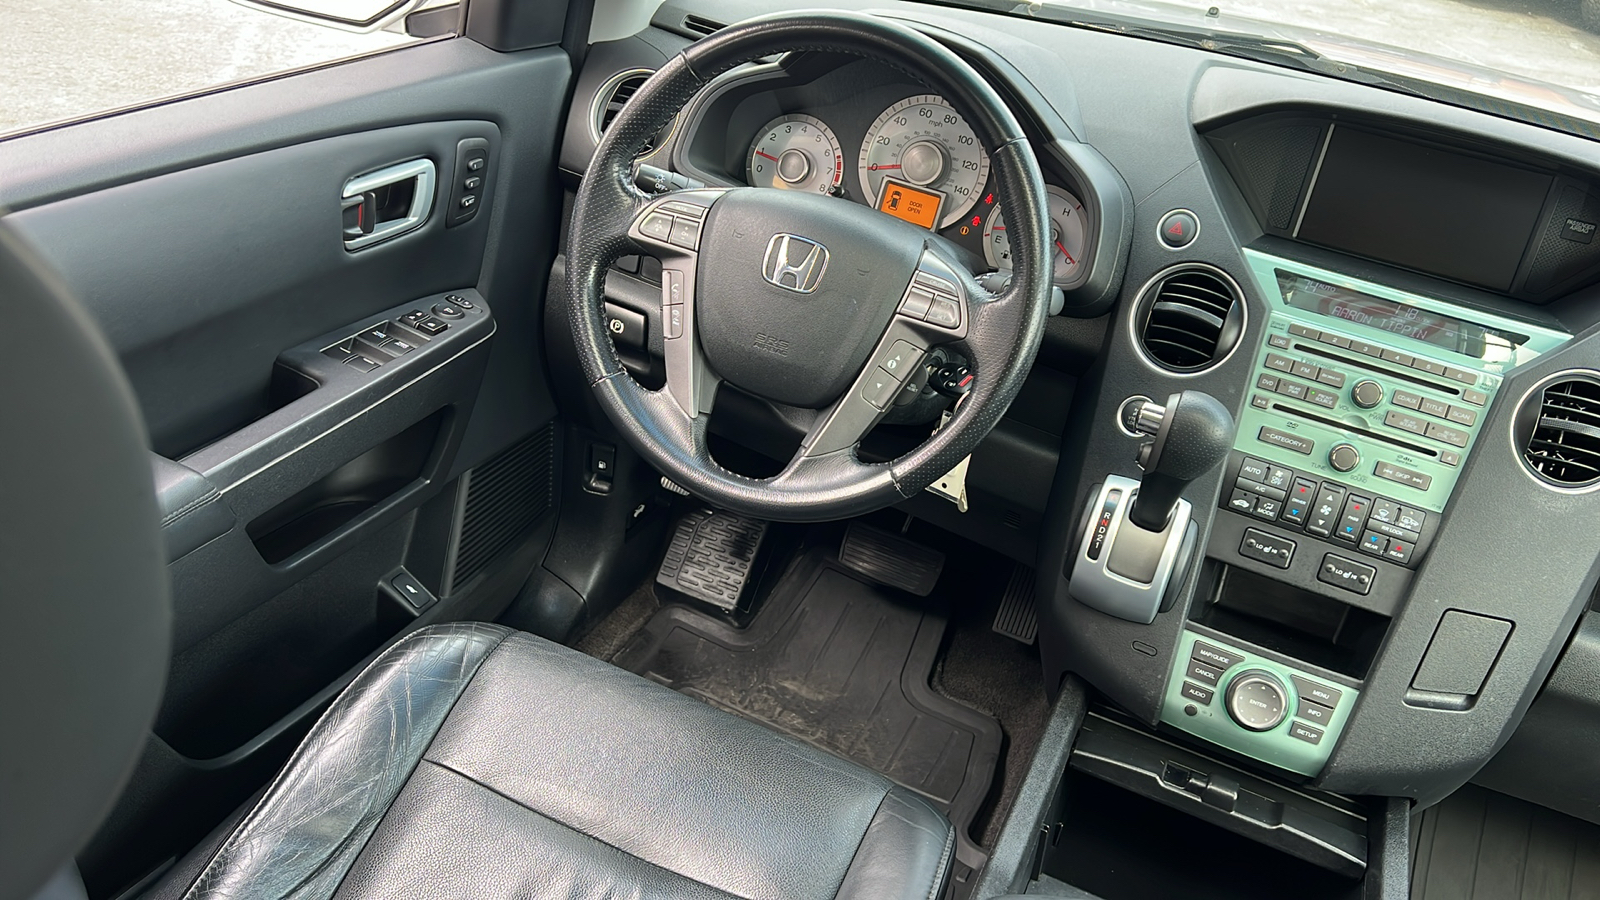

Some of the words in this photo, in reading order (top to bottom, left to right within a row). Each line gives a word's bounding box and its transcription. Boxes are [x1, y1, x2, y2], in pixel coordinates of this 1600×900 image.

[919, 107, 933, 118] 60
[894, 116, 907, 126] 40
[928, 119, 943, 128] mph
[944, 114, 958, 125] 80
[770, 133, 776, 141] 2
[815, 134, 822, 142] 5
[877, 135, 890, 145] 20
[957, 135, 973, 146] 100
[871, 163, 878, 171] 0
[962, 160, 978, 171] 120
[954, 185, 969, 196] 140
[1062, 208, 1070, 217] H
[995, 235, 1002, 244] E
[1318, 284, 1336, 292] AUTO
[1332, 305, 1373, 324] AARON
[1380, 319, 1428, 339] TIPPIN
[756, 332, 789, 350] SRS
[1426, 402, 1444, 412] TITLE
[1452, 410, 1471, 420] SCAN
[1244, 466, 1261, 475] AUTO
[1311, 463, 1327, 471] TUNE
[1257, 507, 1275, 517] MODE
[1364, 542, 1378, 550] REAR
[1390, 550, 1404, 558] REAR
[1195, 667, 1216, 680] CANCEL
[1189, 688, 1206, 699] AUDIO
[1312, 689, 1330, 700] MENU
[1249, 699, 1267, 709] ENTER
[1307, 708, 1322, 718] INFO
[1296, 728, 1318, 739] SETUP
